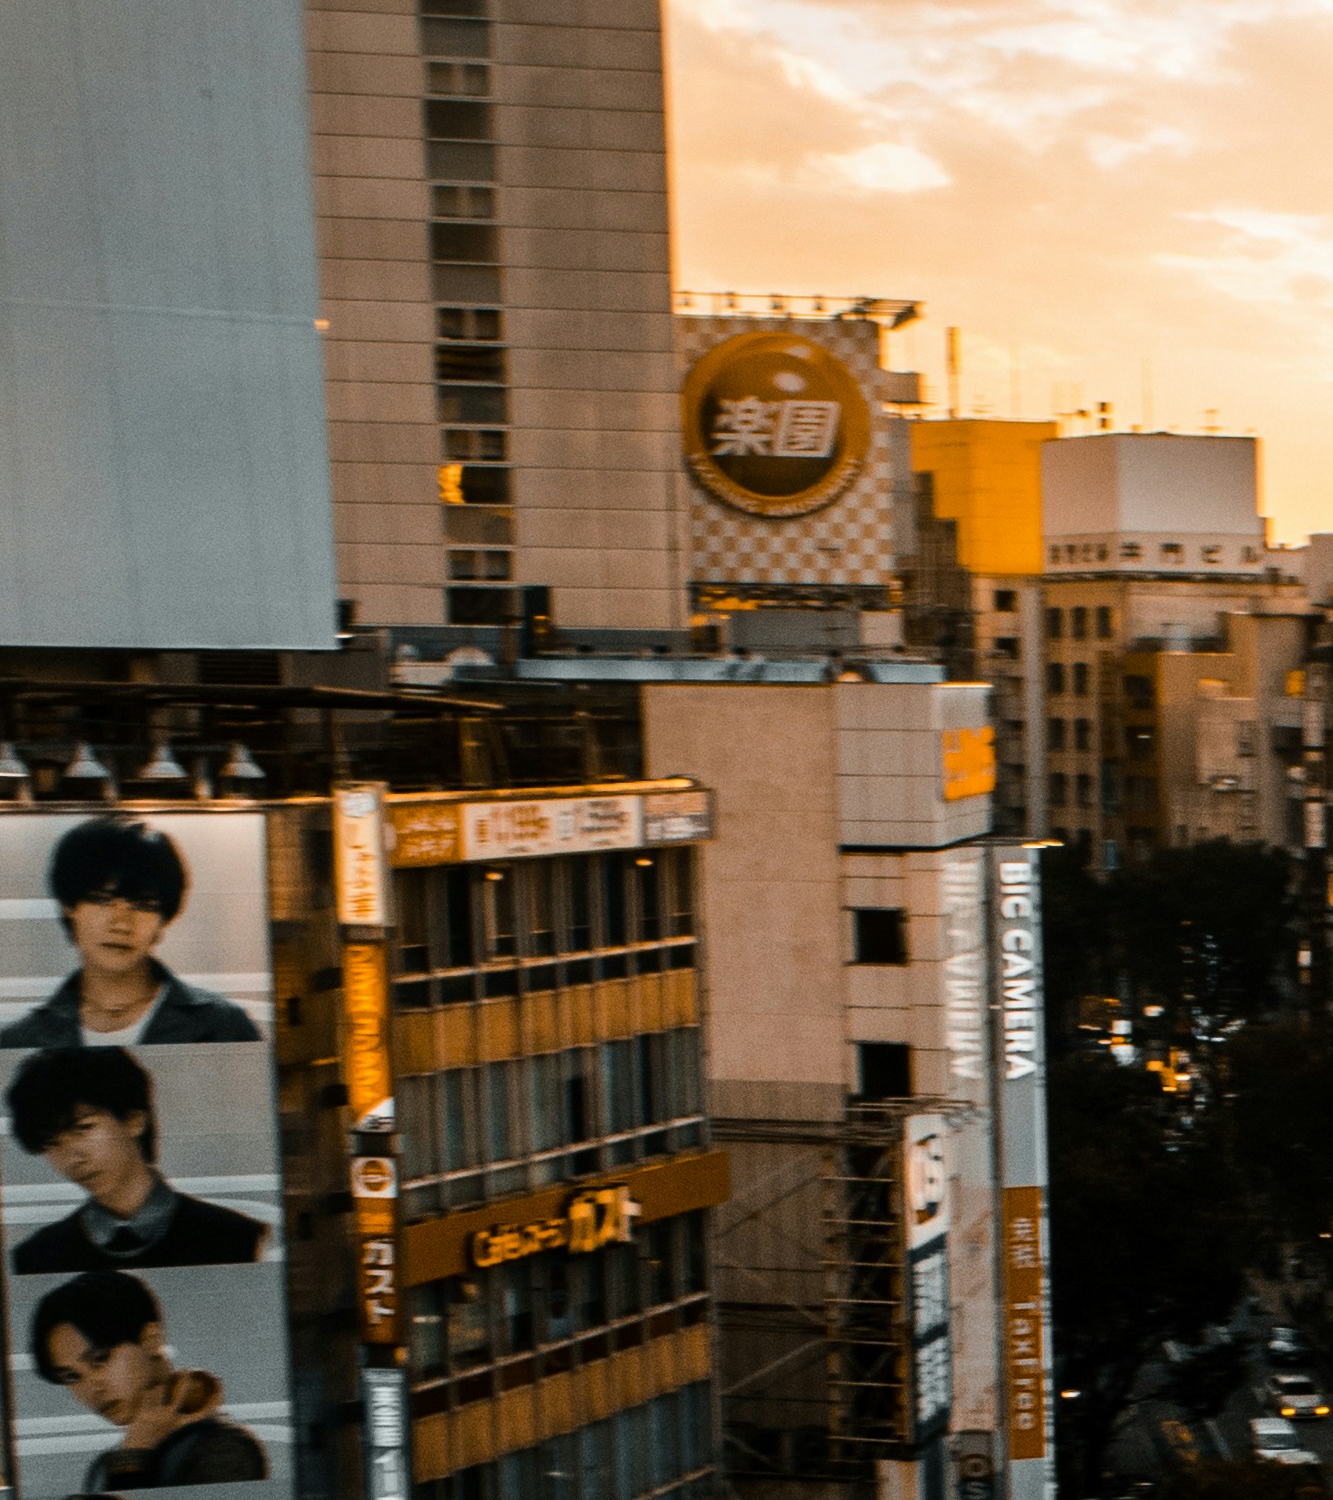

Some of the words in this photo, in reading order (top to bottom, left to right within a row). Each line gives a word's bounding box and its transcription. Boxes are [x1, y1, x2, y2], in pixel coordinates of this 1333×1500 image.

[1000, 861, 1032, 920] BIC
[1002, 927, 1039, 1081] CAMERA
[361, 1237, 397, 1325] ガスト
